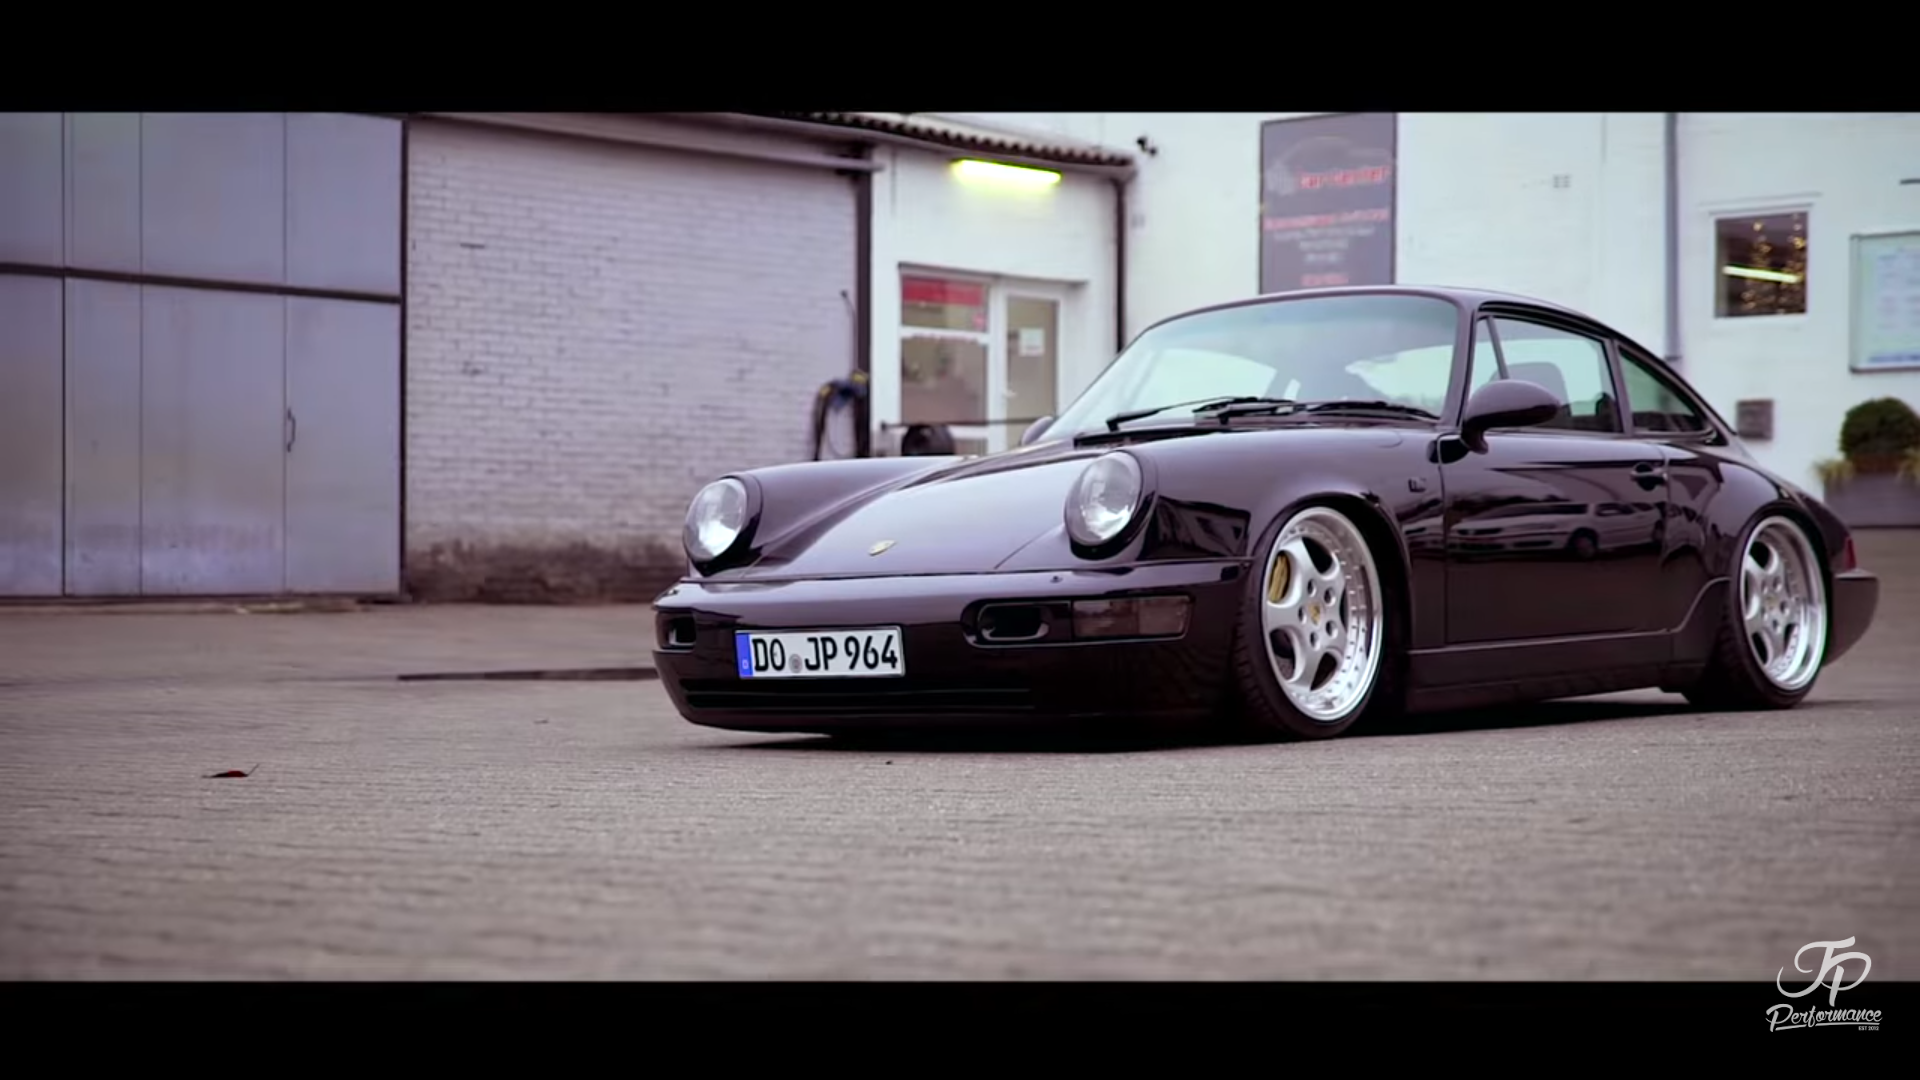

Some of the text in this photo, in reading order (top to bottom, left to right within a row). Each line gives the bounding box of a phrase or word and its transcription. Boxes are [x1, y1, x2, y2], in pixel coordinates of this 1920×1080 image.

[751, 634, 898, 671] DO JP 964
